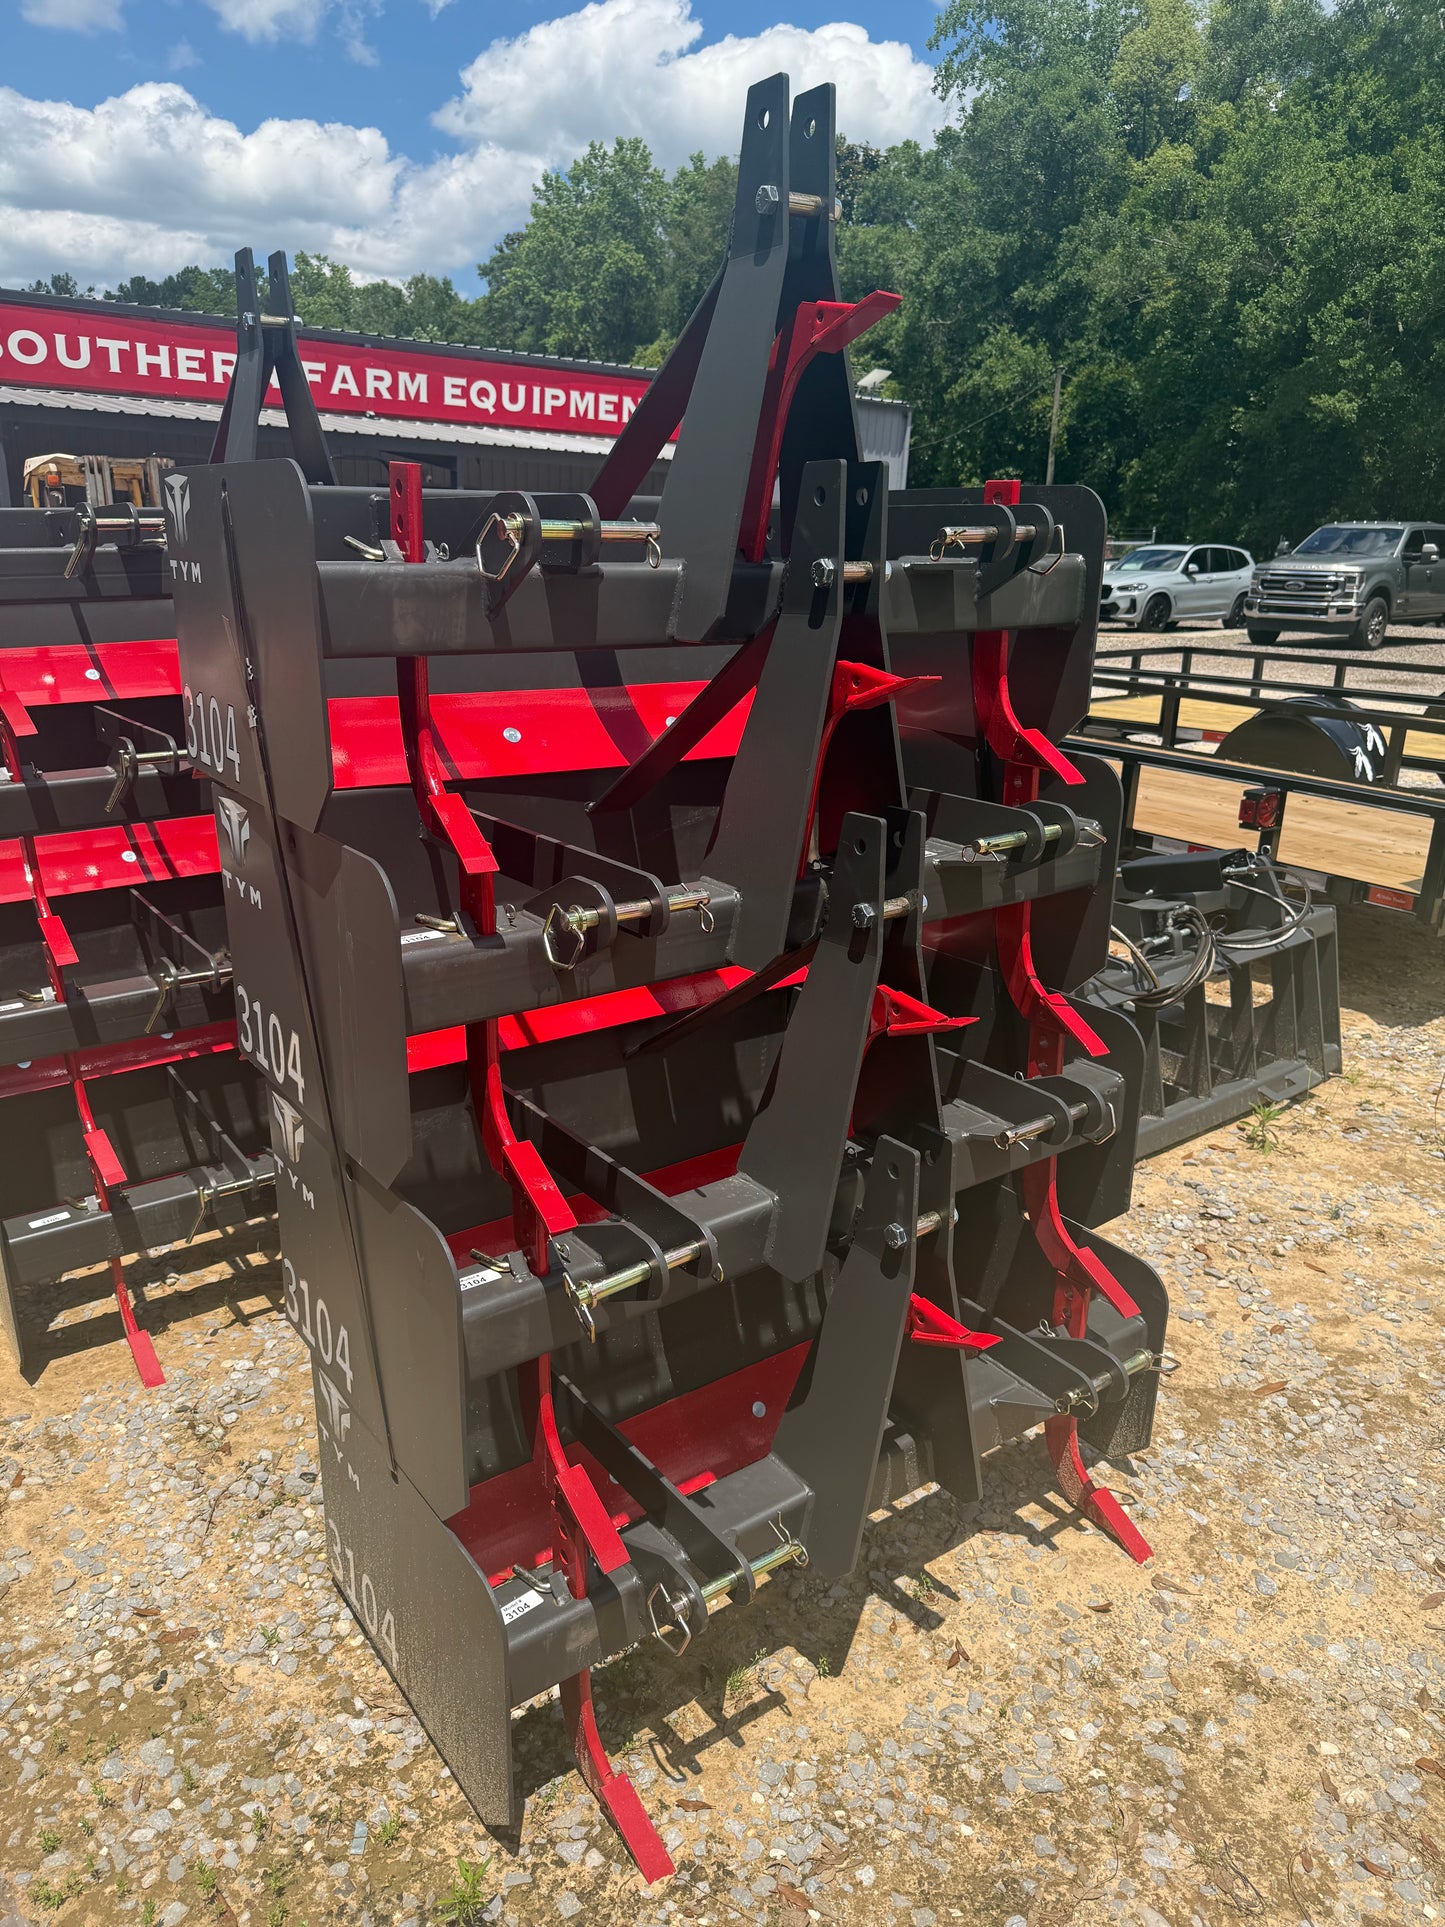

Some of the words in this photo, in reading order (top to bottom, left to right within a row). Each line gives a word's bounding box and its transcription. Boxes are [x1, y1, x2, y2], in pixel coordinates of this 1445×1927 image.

[0, 329, 280, 390] OUTHER
[301, 360, 429, 404] FARM
[443, 376, 643, 424] EQUIPMEN
[170, 560, 202, 583] TYM
[183, 685, 240, 783] 3104
[222, 868, 262, 910] TYM
[237, 984, 305, 1105] 3104
[273, 1153, 315, 1211] TYM
[461, 1277, 487, 1289] 3104
[283, 1258, 354, 1394] 3104
[319, 1420, 361, 1492] TYM
[328, 1518, 399, 1671] 3104
[505, 1602, 530, 1620] 3104
